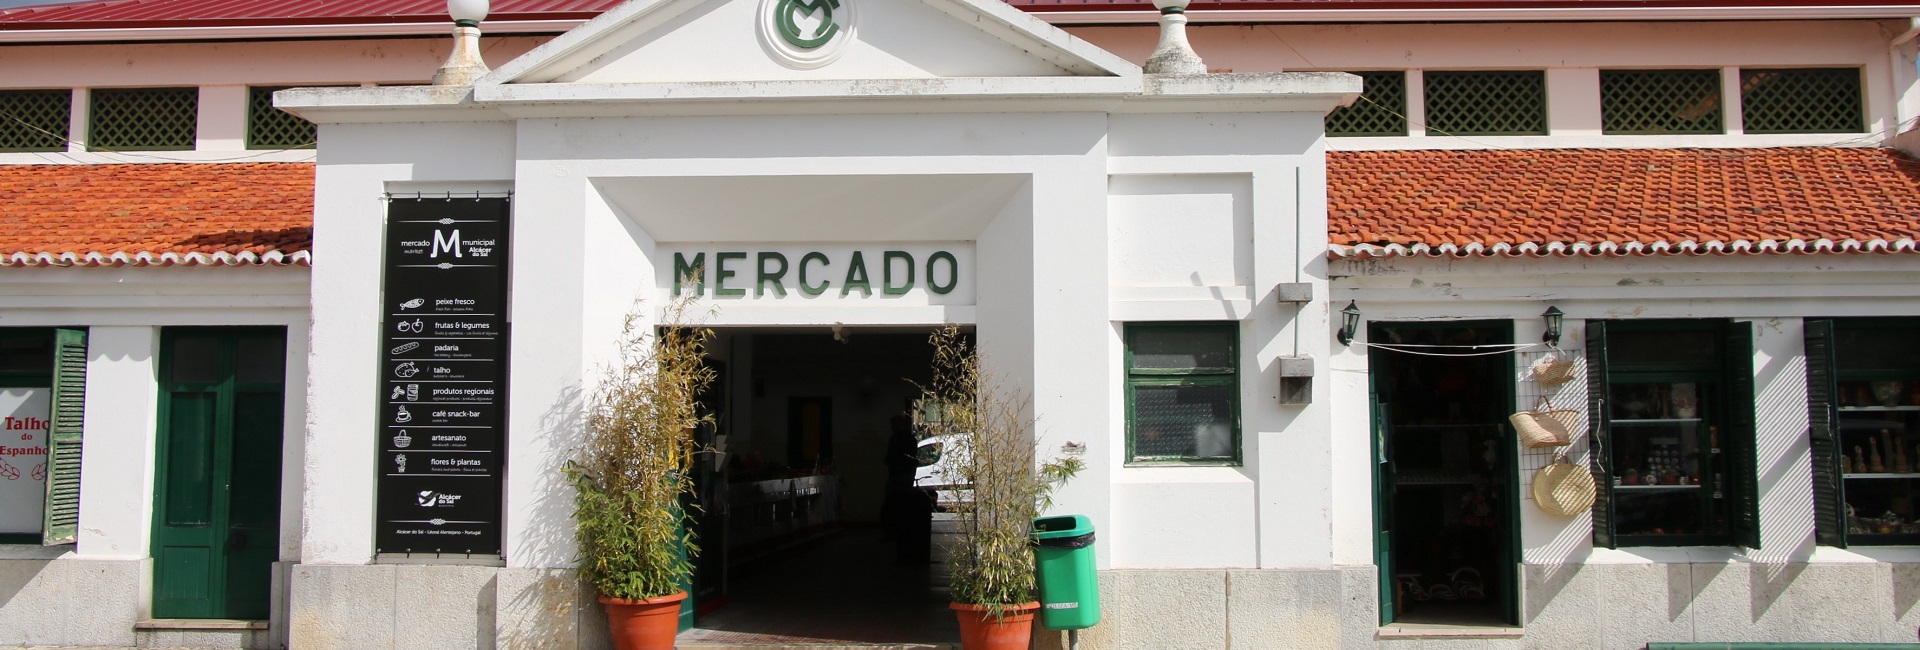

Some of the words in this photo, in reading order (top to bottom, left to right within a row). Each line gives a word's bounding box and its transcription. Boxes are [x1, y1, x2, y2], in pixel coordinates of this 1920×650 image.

[430, 229, 462, 258] M
[462, 239, 495, 247] municipal
[674, 251, 958, 296] MERCADO
[435, 298, 453, 306] peixe
[461, 322, 490, 331] legumes
[434, 344, 459, 352] padaria
[433, 366, 451, 374] talho
[432, 388, 463, 396] produtos
[463, 388, 494, 396] regionais
[21, 433, 33, 441] do
[430, 458, 450, 466] flores
[456, 459, 482, 467] plantas
